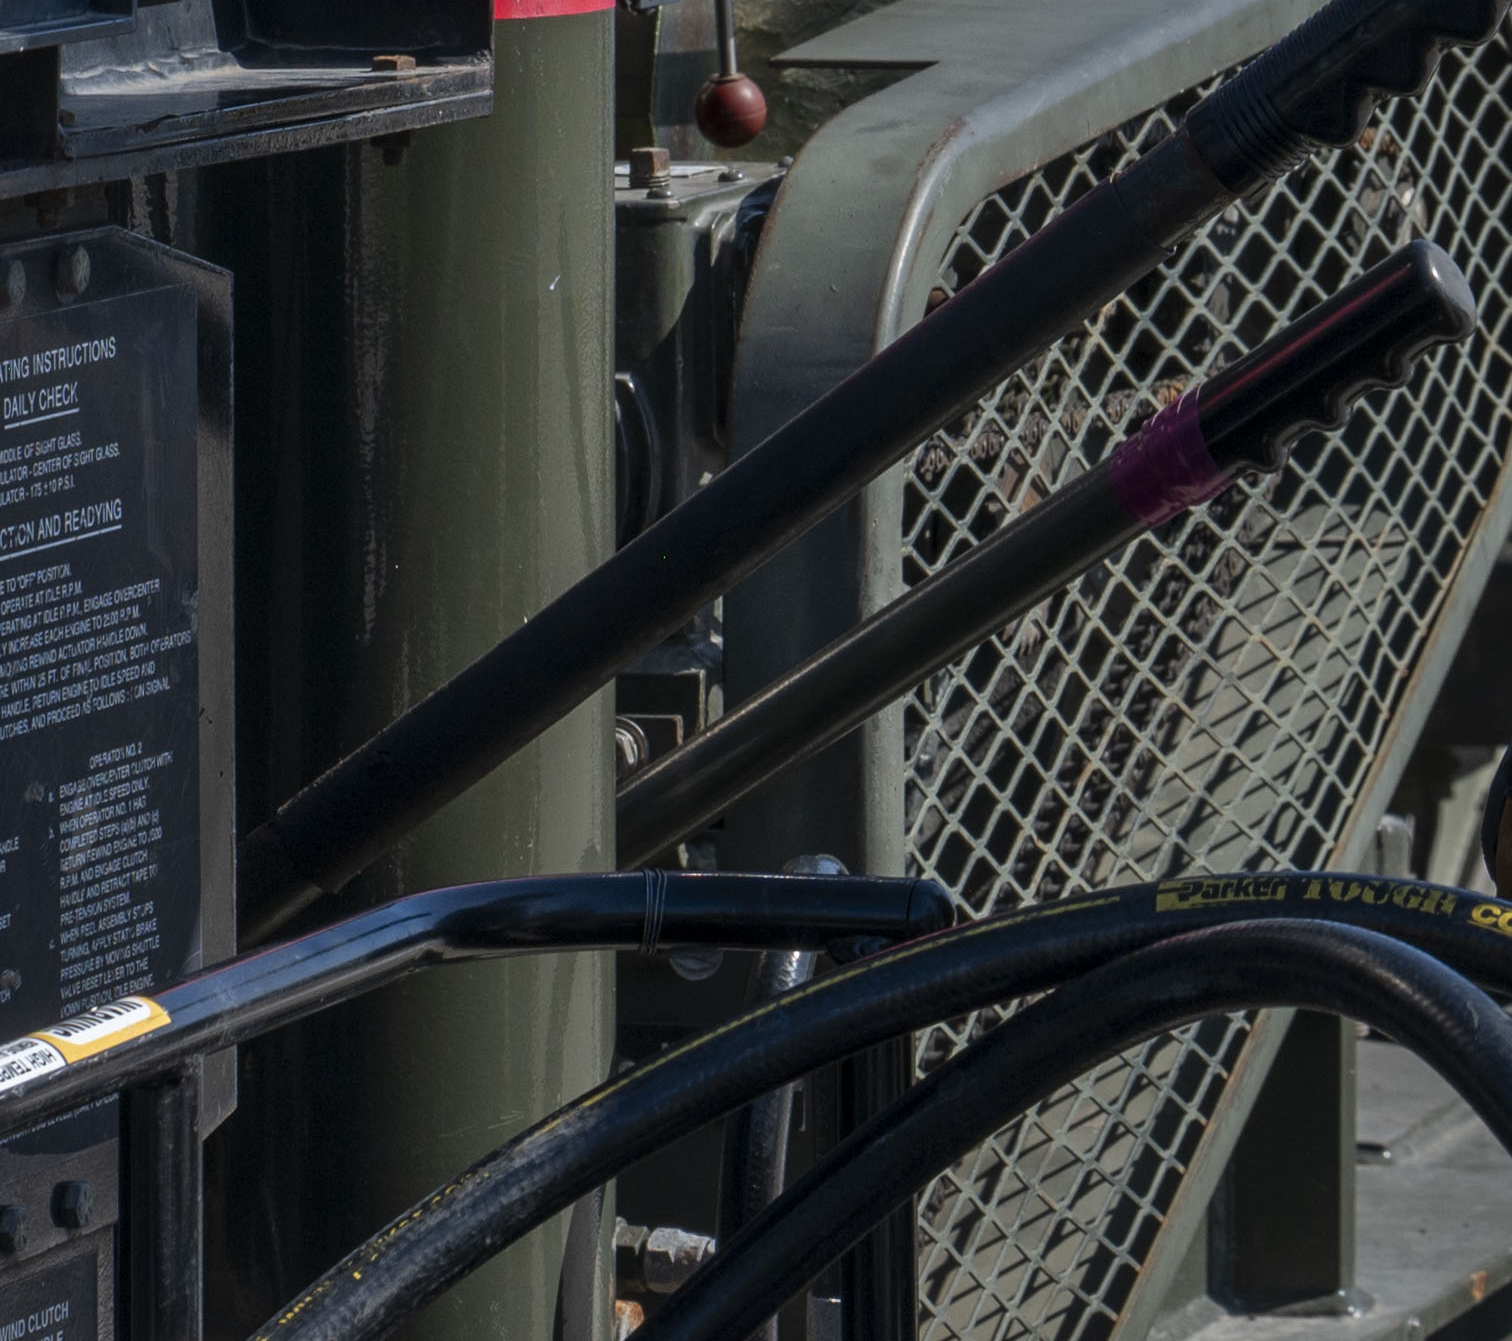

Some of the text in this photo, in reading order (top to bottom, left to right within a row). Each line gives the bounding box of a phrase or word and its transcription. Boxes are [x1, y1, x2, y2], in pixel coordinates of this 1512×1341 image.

[32, 336, 116, 375] INSTRUCTIONS
[4, 381, 77, 418] DAILY CHECK
[24, 443, 33, 458] OF
[34, 438, 56, 455] SIGHT
[32, 457, 60, 476] CENTER
[63, 454, 72, 468] OF
[38, 515, 60, 540] AND
[64, 498, 122, 533] READYING
[6, 578, 15, 592] TO
[84, 592, 112, 611] ENGAGE
[114, 578, 160, 603] OVERCENTER
[2, 594, 33, 614] OPERATE
[35, 591, 42, 605] AT
[92, 615, 102, 629] TO
[60, 664, 70, 679] OF
[60, 829, 97, 853] COMPLETED
[1303, 877, 1457, 917] TOUGH
[32, 1047, 56, 1069] HIGH
[27, 1300, 70, 1334] CLUTCH
